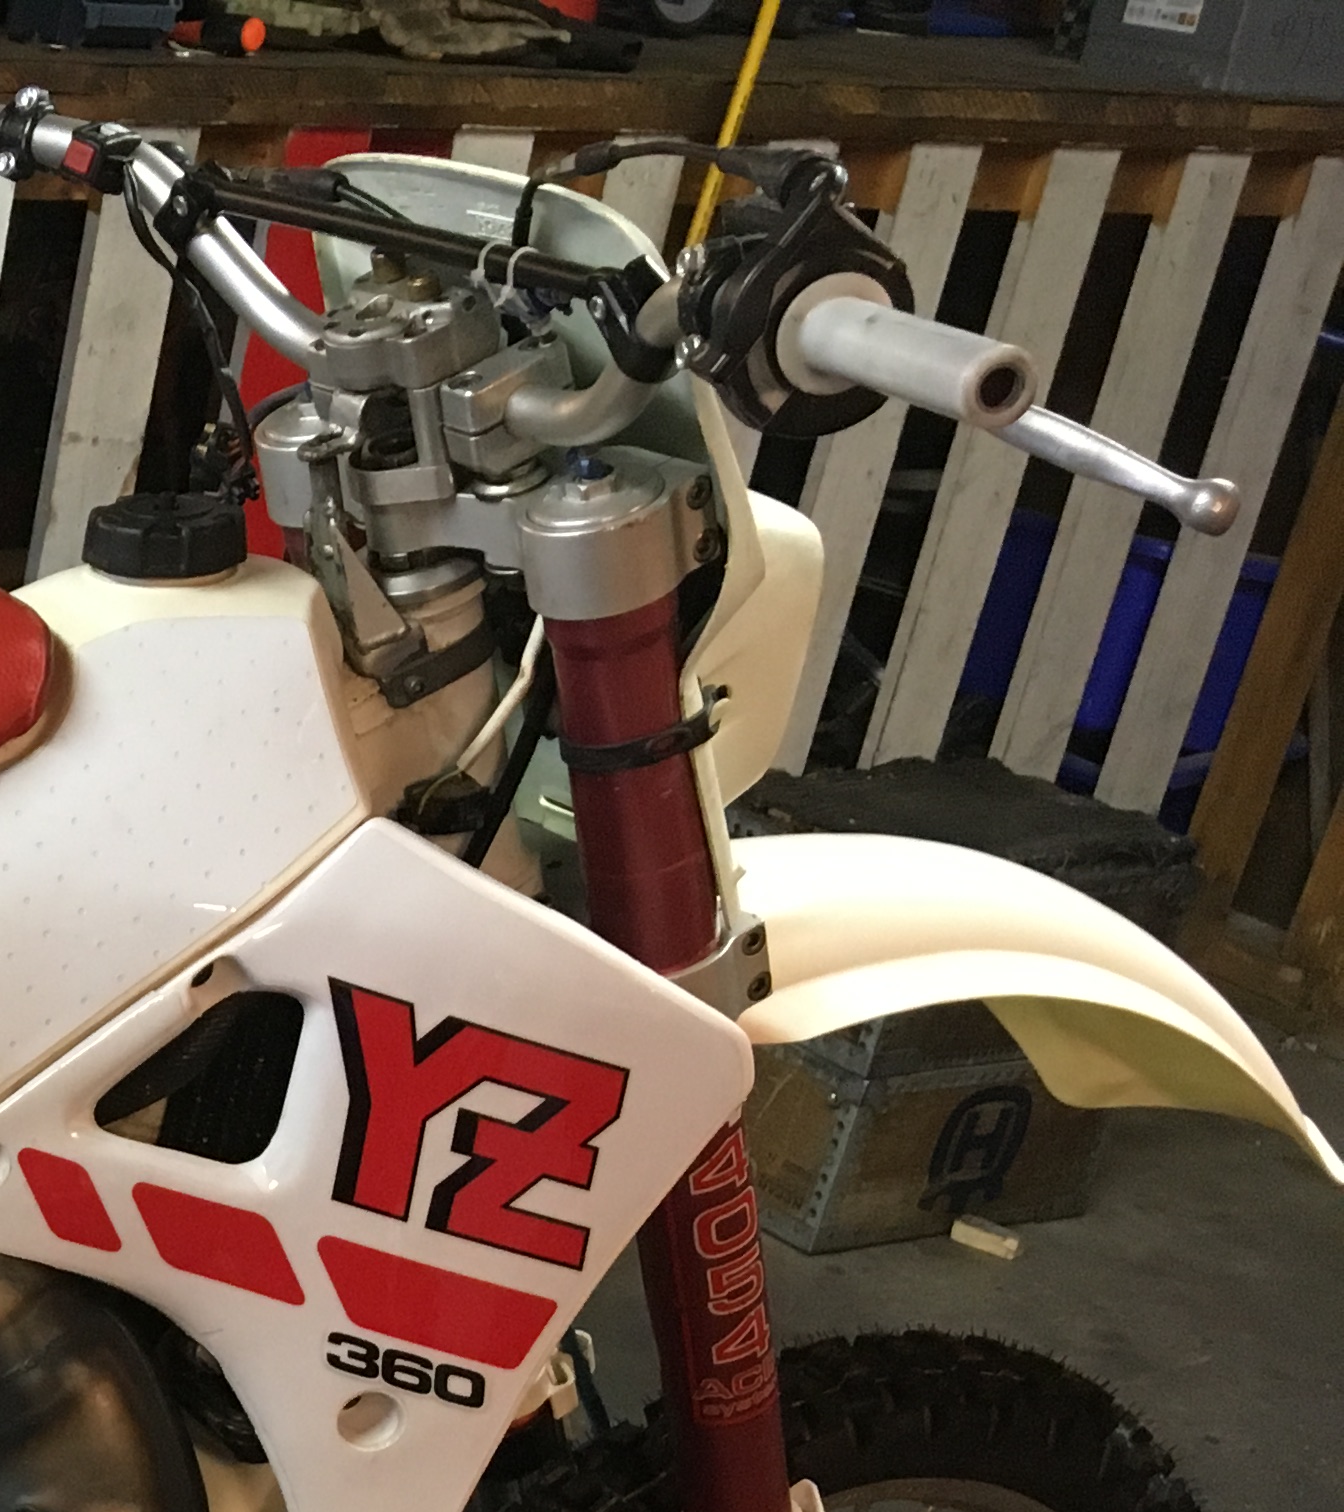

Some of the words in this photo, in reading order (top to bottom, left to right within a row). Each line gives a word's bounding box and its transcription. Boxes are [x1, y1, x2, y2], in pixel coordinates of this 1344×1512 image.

[327, 976, 630, 1271] YZ
[689, 1128, 770, 1365] 4054
[325, 1331, 486, 1410] 360
